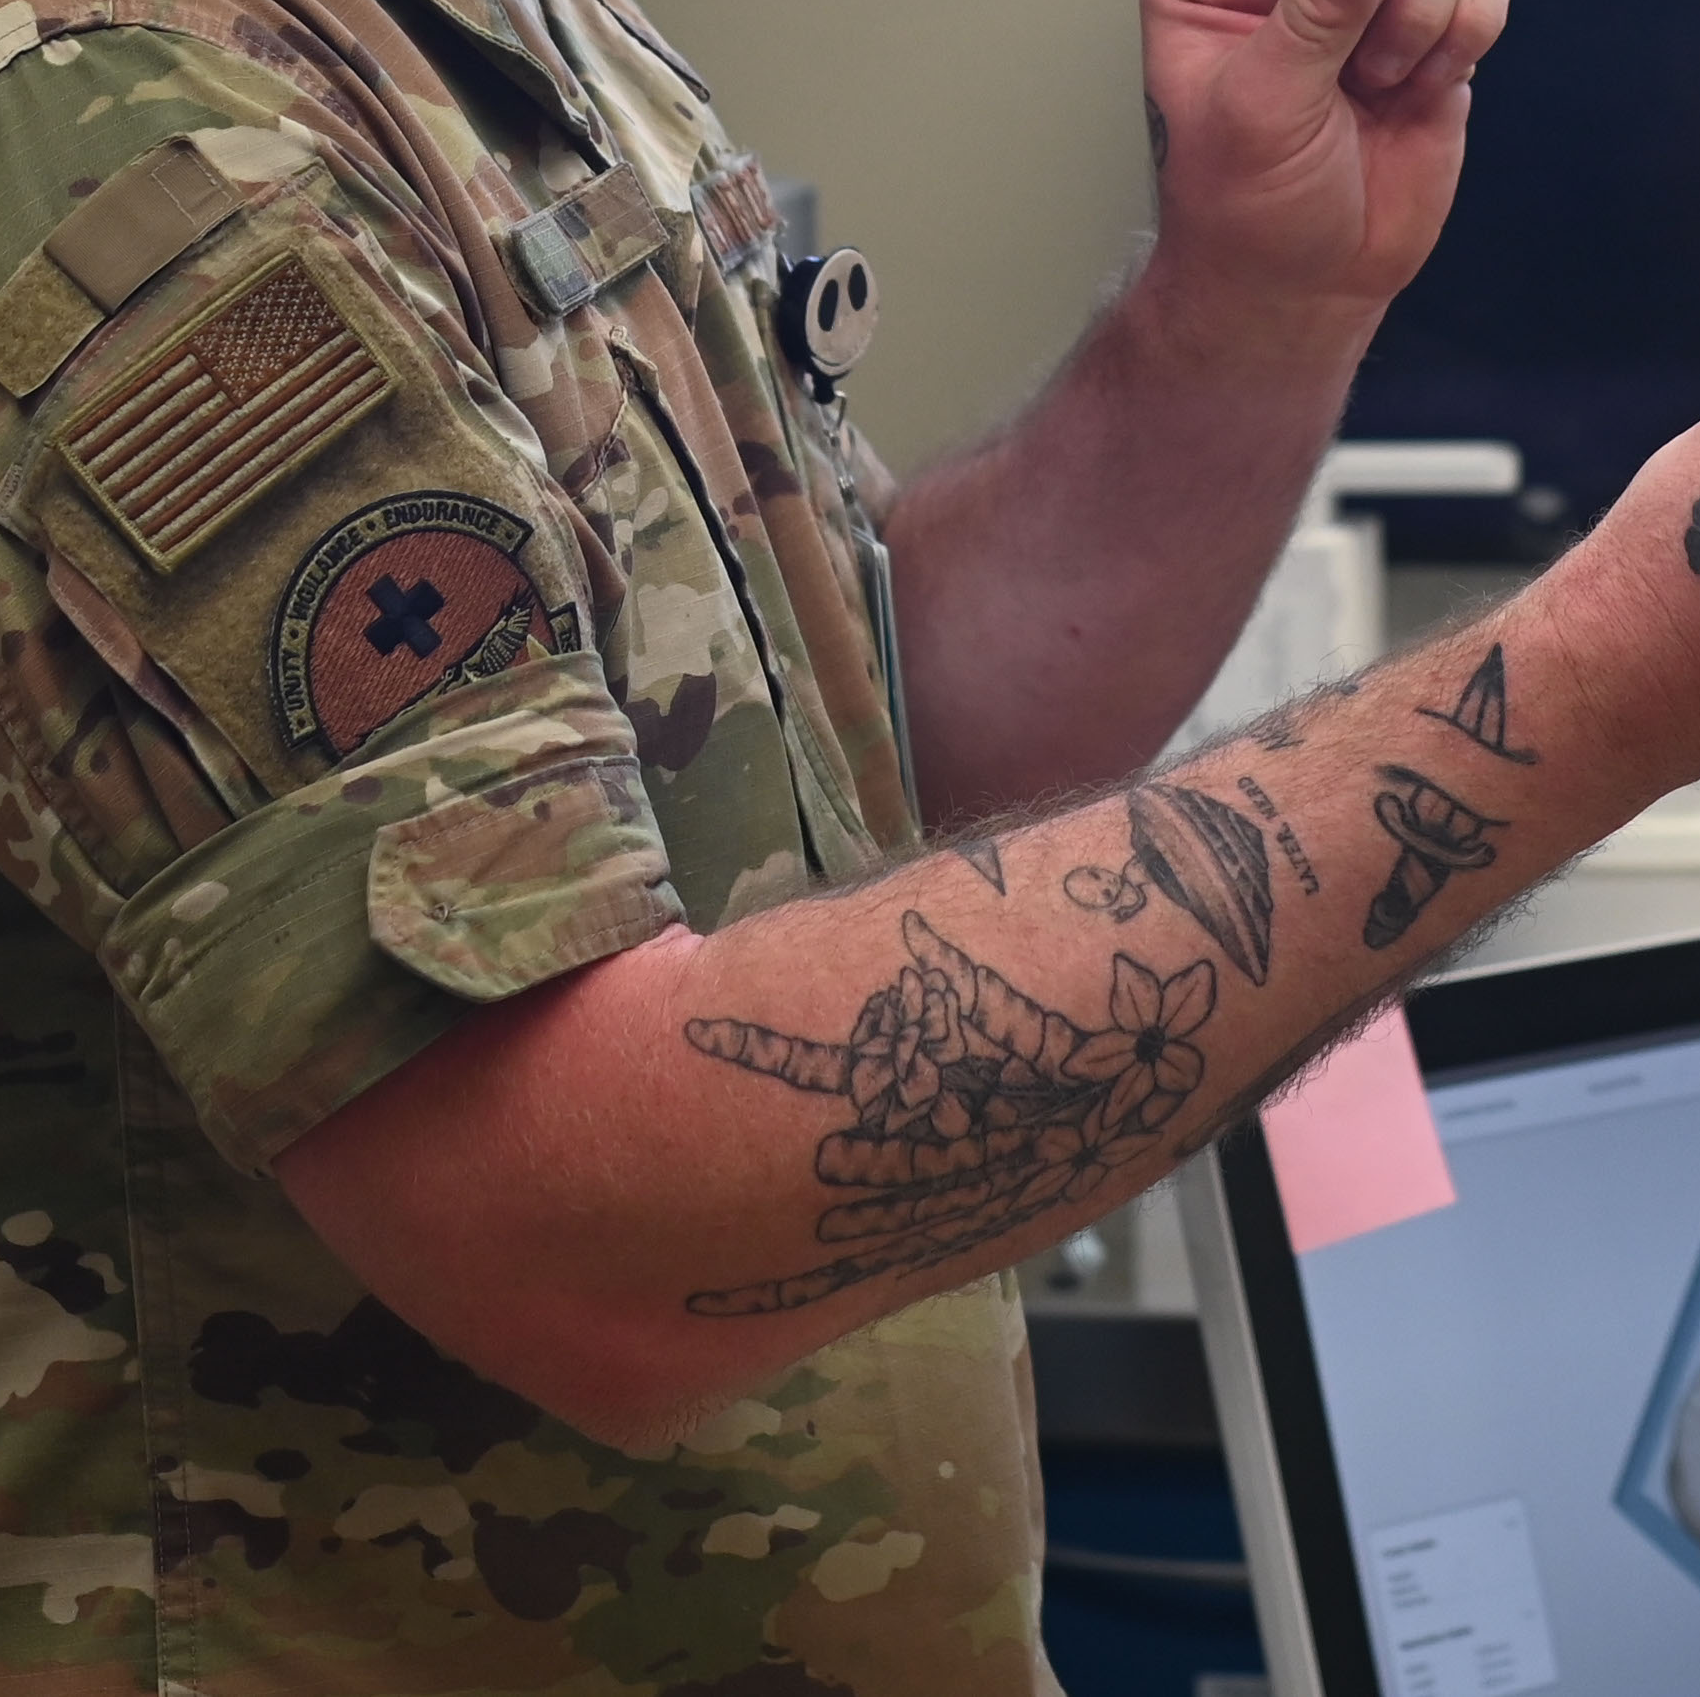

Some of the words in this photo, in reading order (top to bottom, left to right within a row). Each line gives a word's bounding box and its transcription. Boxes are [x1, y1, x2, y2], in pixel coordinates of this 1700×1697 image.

[382, 501, 501, 534] ENDURANCE
[287, 525, 365, 620] VIGILANCE
[282, 649, 303, 710] UNITY
